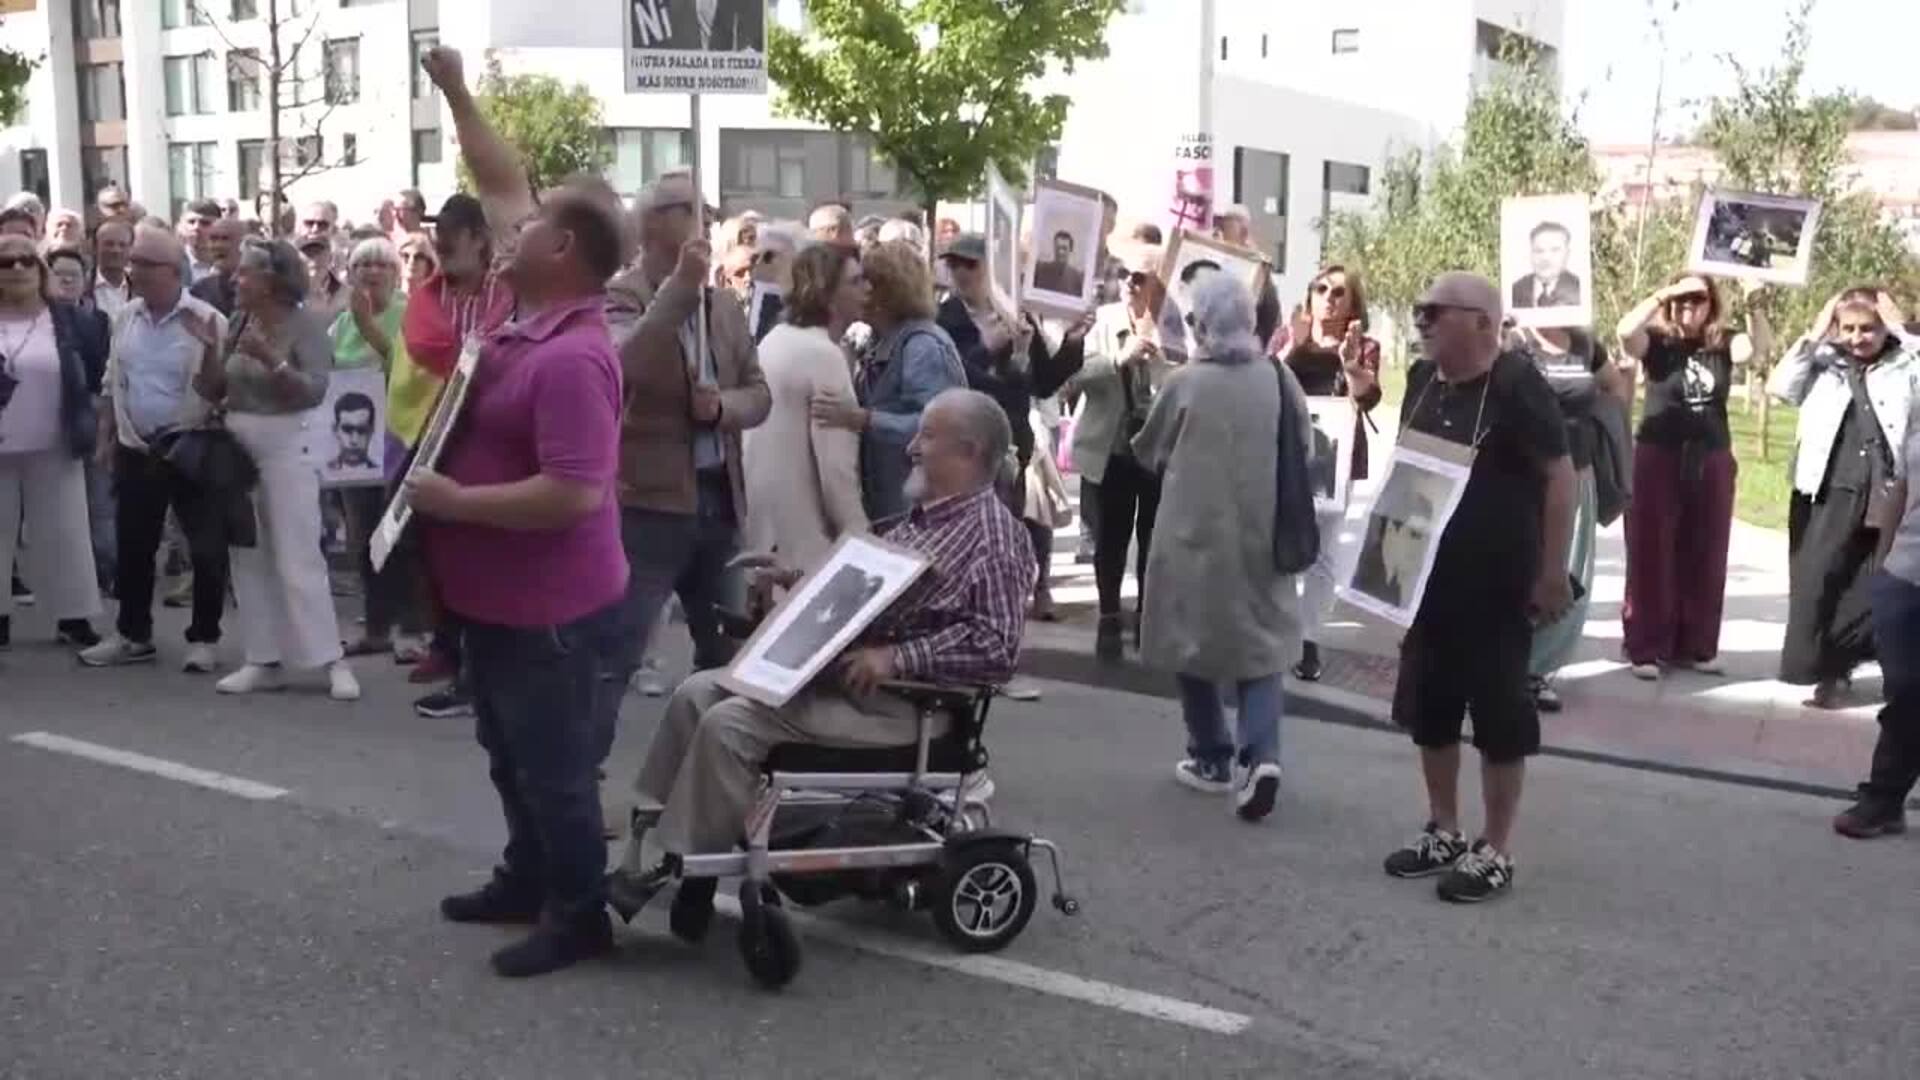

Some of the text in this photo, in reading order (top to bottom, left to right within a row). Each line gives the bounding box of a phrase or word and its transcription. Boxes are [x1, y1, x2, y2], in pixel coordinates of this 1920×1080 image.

[668, 55, 709, 69] PALADA
[712, 57, 725, 70] DE
[727, 57, 763, 70] TIERRA
[663, 75, 695, 89] SOBRE
